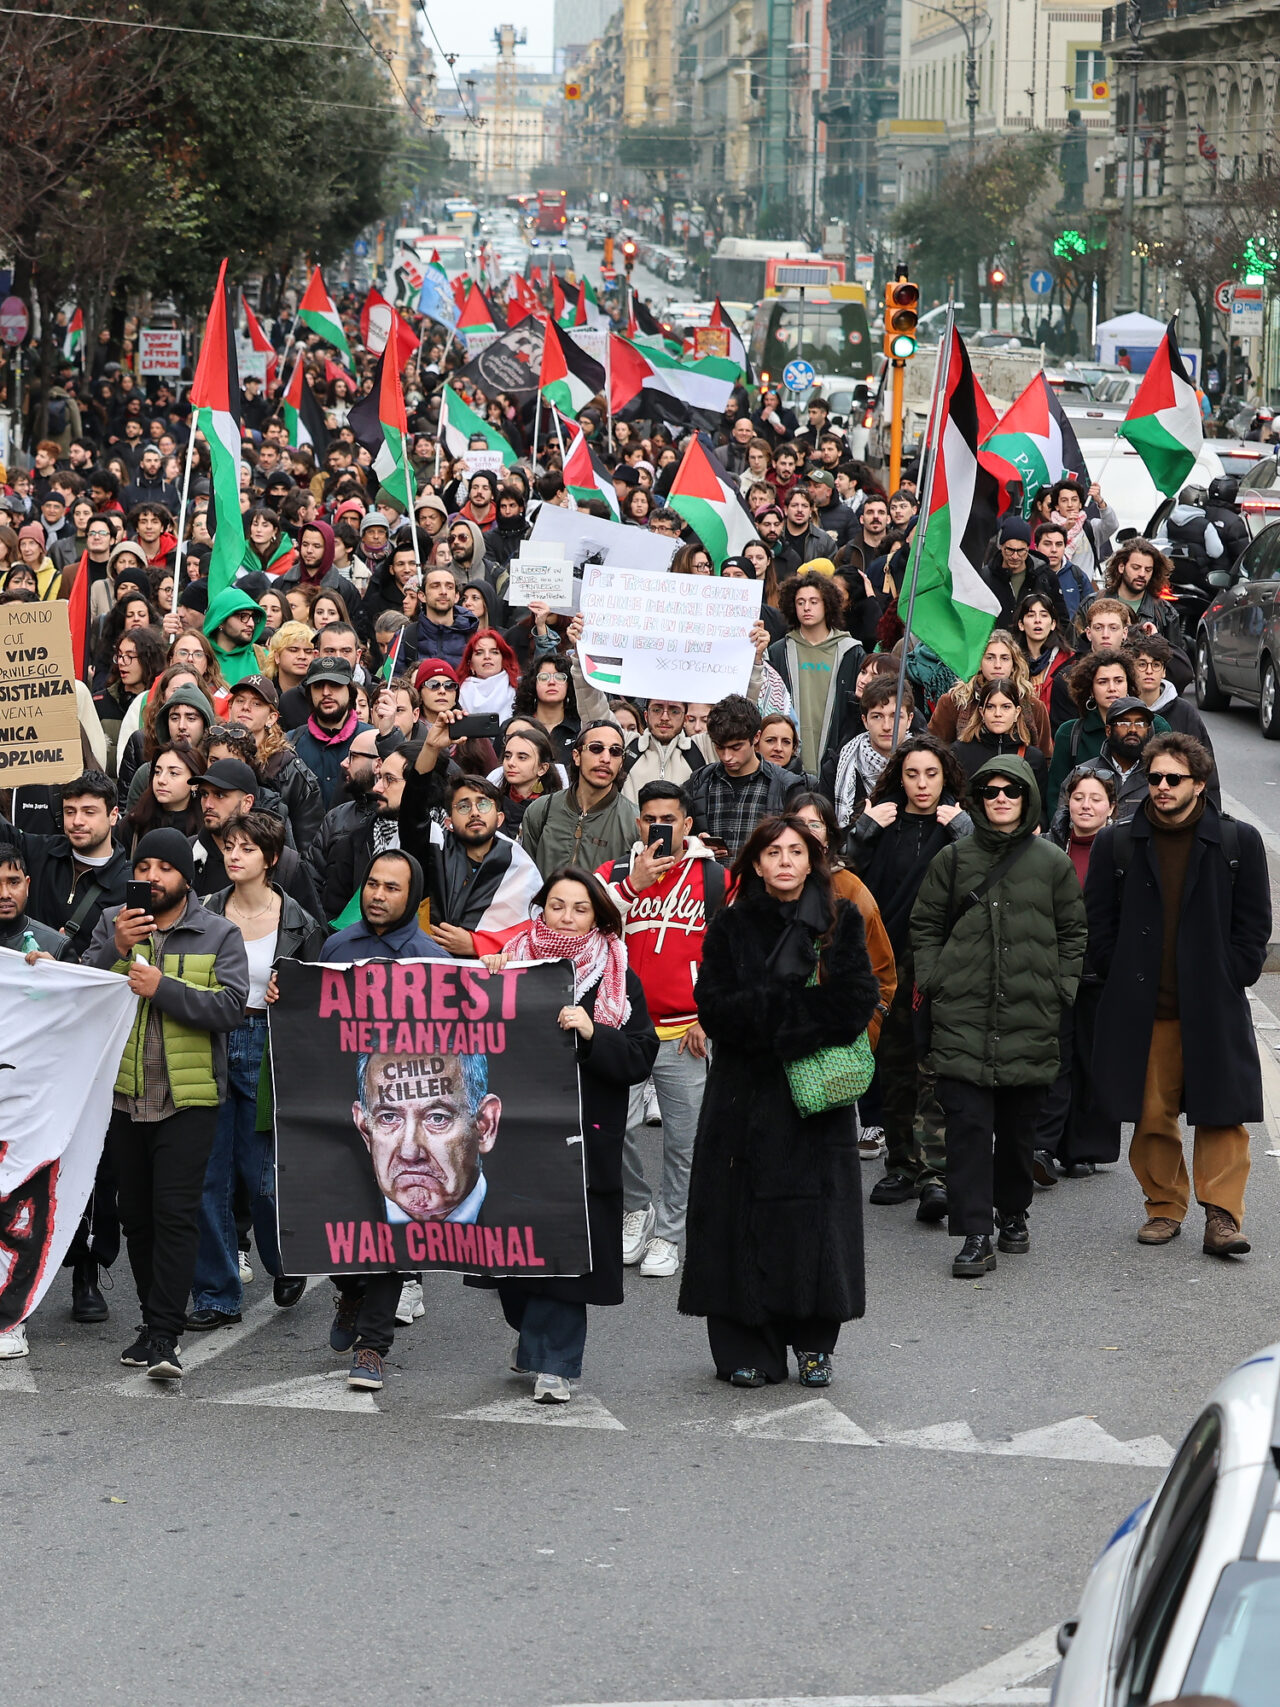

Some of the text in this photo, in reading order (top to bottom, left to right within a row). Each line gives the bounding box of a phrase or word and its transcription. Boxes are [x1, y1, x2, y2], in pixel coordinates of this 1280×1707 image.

[8, 610, 52, 626] MONDO
[3, 632, 25, 646] CUI
[612, 632, 628, 648] UN
[631, 884, 706, 936] rooklyn
[319, 962, 528, 1021] ARREST
[339, 1020, 506, 1054] NETANYAHU
[382, 1057, 445, 1080] CHILD
[377, 1076, 454, 1104] KILLER
[325, 1221, 546, 1268] WAR CRIMINAL
